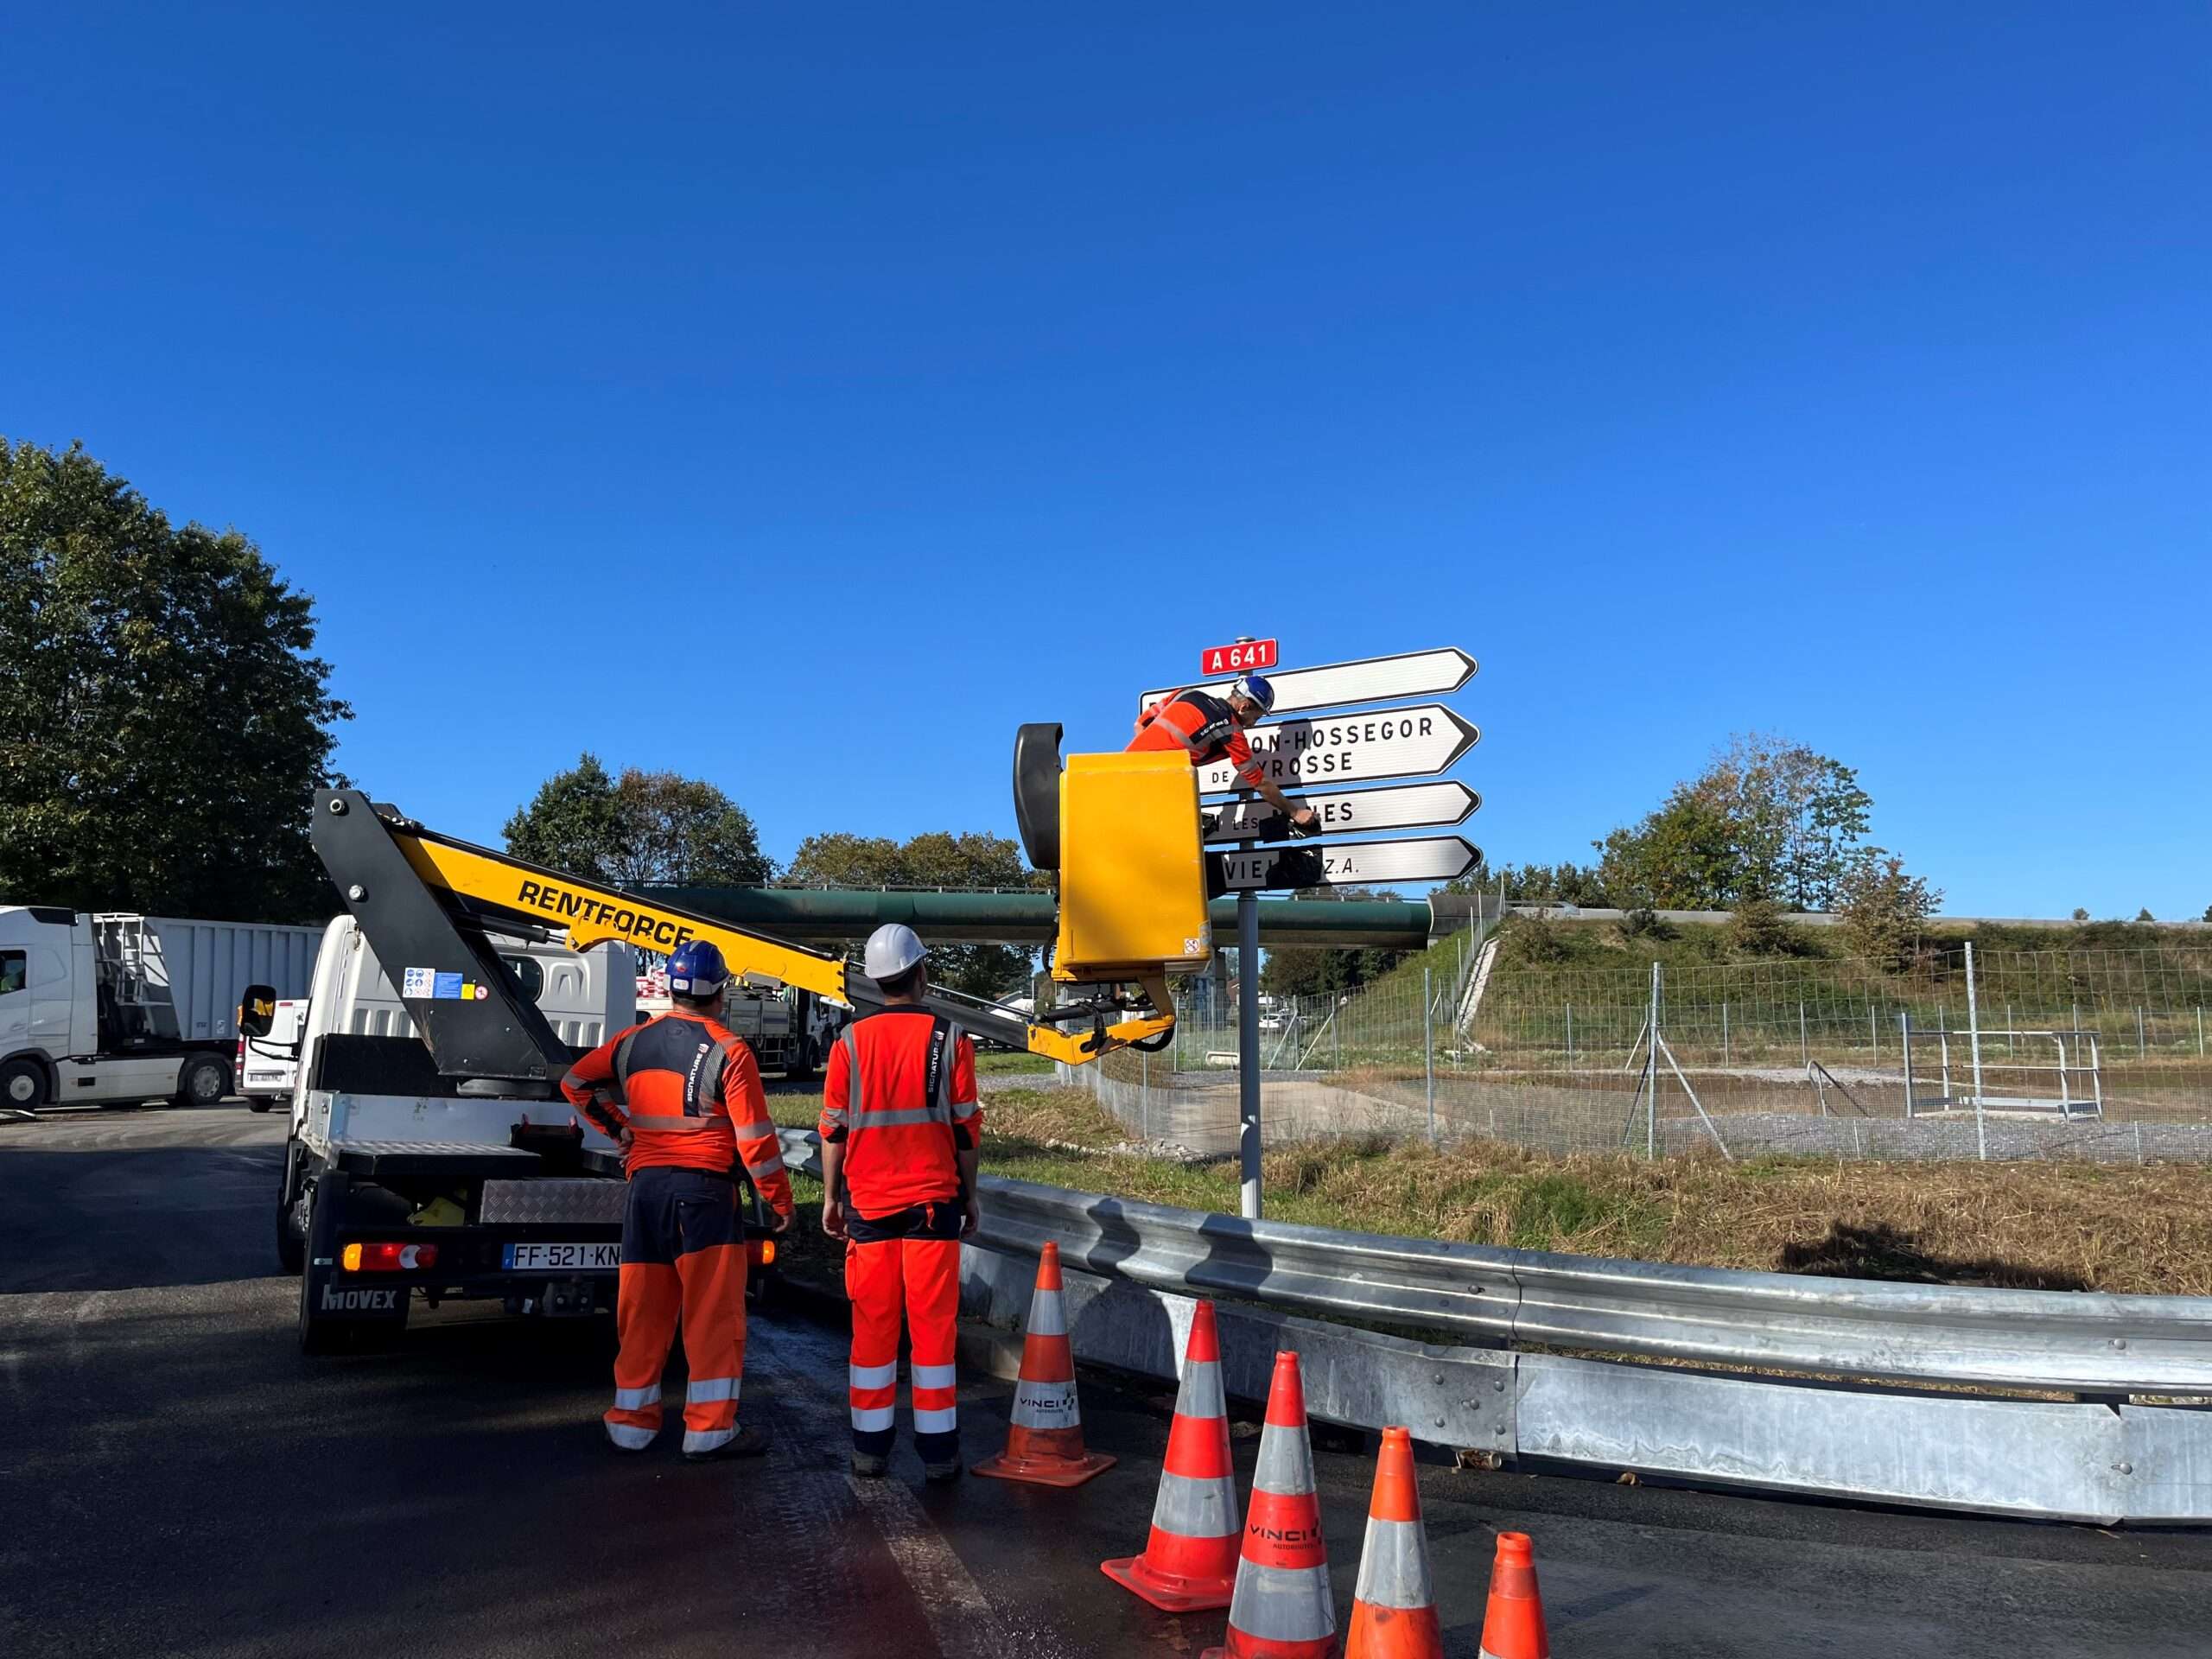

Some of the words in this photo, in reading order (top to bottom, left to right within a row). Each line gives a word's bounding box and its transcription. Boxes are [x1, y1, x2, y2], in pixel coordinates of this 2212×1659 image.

[1211, 651, 1224, 671] A
[1230, 644, 1266, 667] 641
[1252, 717, 1433, 754] ON-HOSSEGOR
[1211, 771, 1229, 784] DE
[1256, 752, 1353, 778] YROSSE
[1233, 817, 1259, 830] LES
[1224, 859, 1273, 880] VIE
[1324, 857, 1360, 874] Z.A.
[518, 880, 695, 948] RENTFORCE
[321, 1284, 397, 1310] MOVEX
[1020, 1396, 1059, 1408] VINCI
[1249, 1522, 1307, 1542] VINCI
